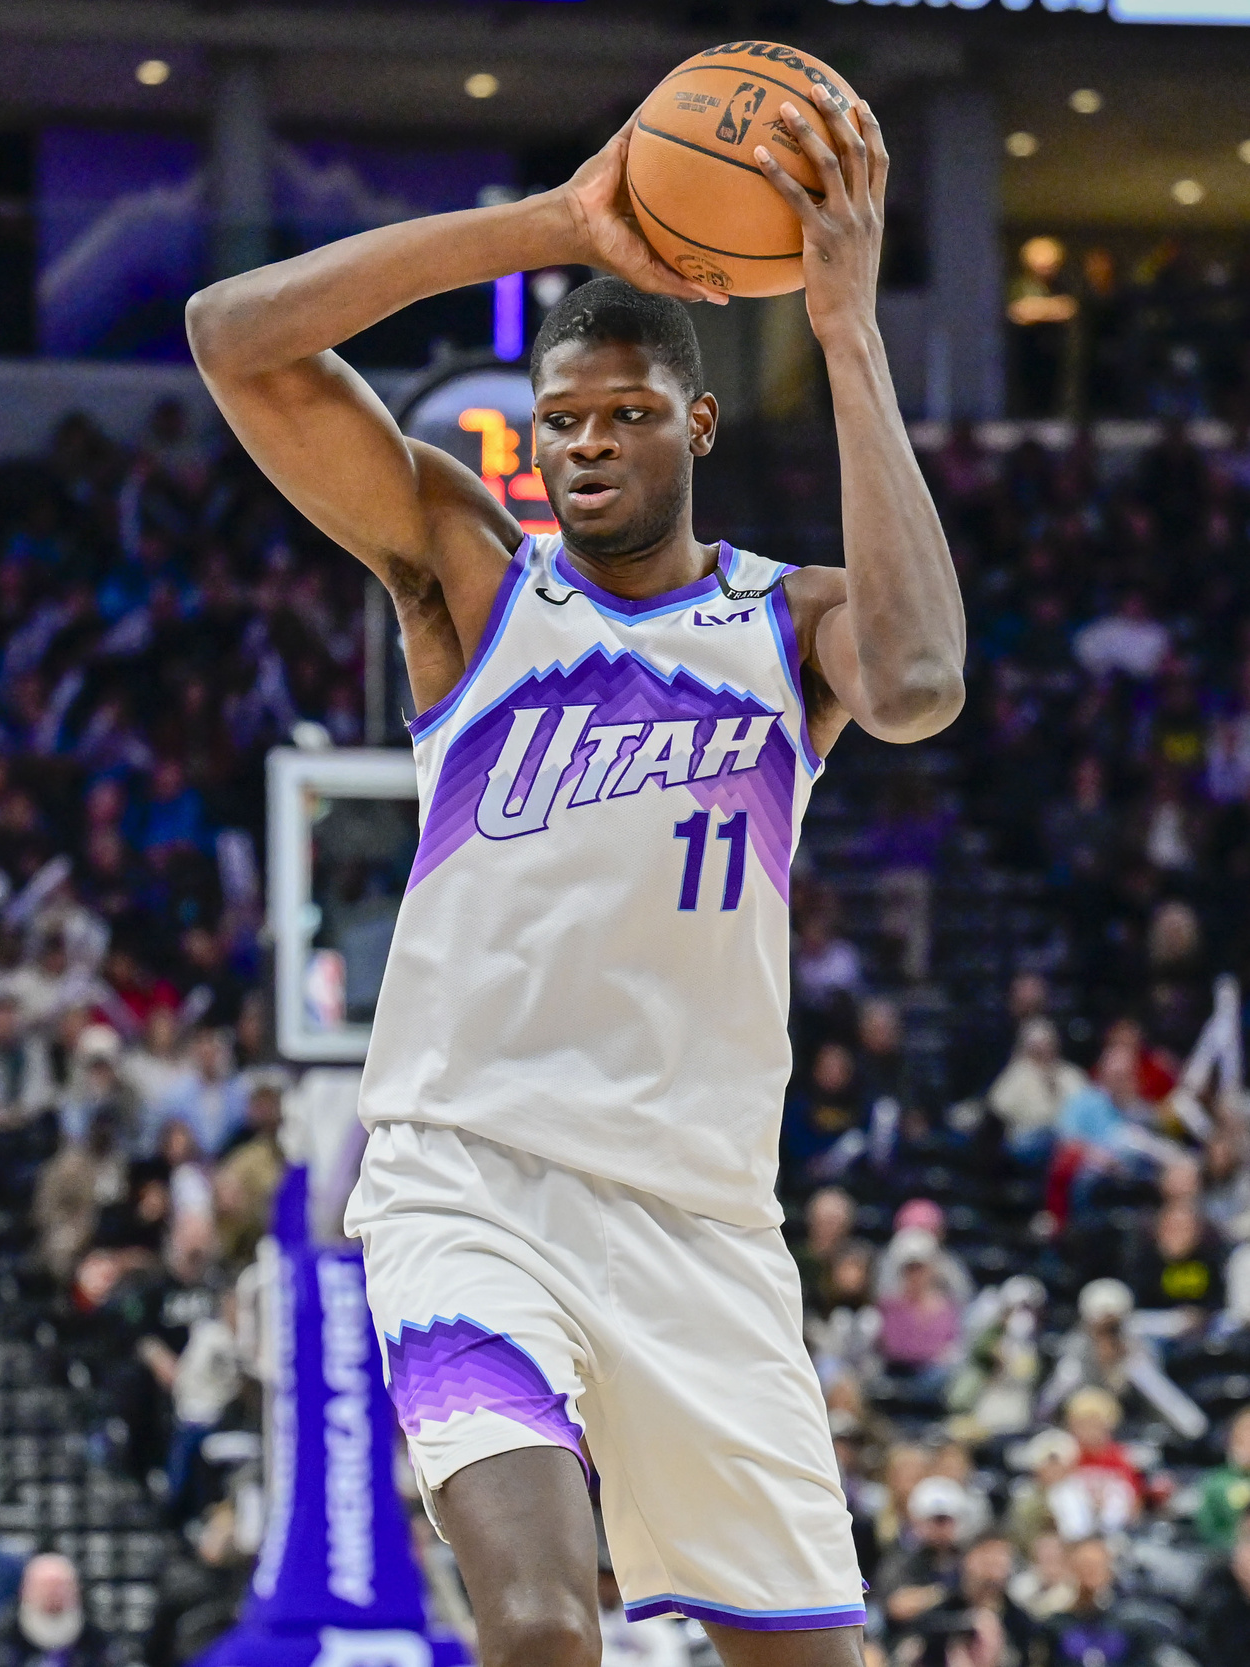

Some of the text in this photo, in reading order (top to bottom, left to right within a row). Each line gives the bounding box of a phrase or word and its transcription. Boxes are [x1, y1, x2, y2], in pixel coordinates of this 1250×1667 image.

[693, 606, 757, 627] LVT
[727, 589, 762, 599] FRANK
[474, 702, 784, 841] UTAH
[673, 809, 748, 912] 11
